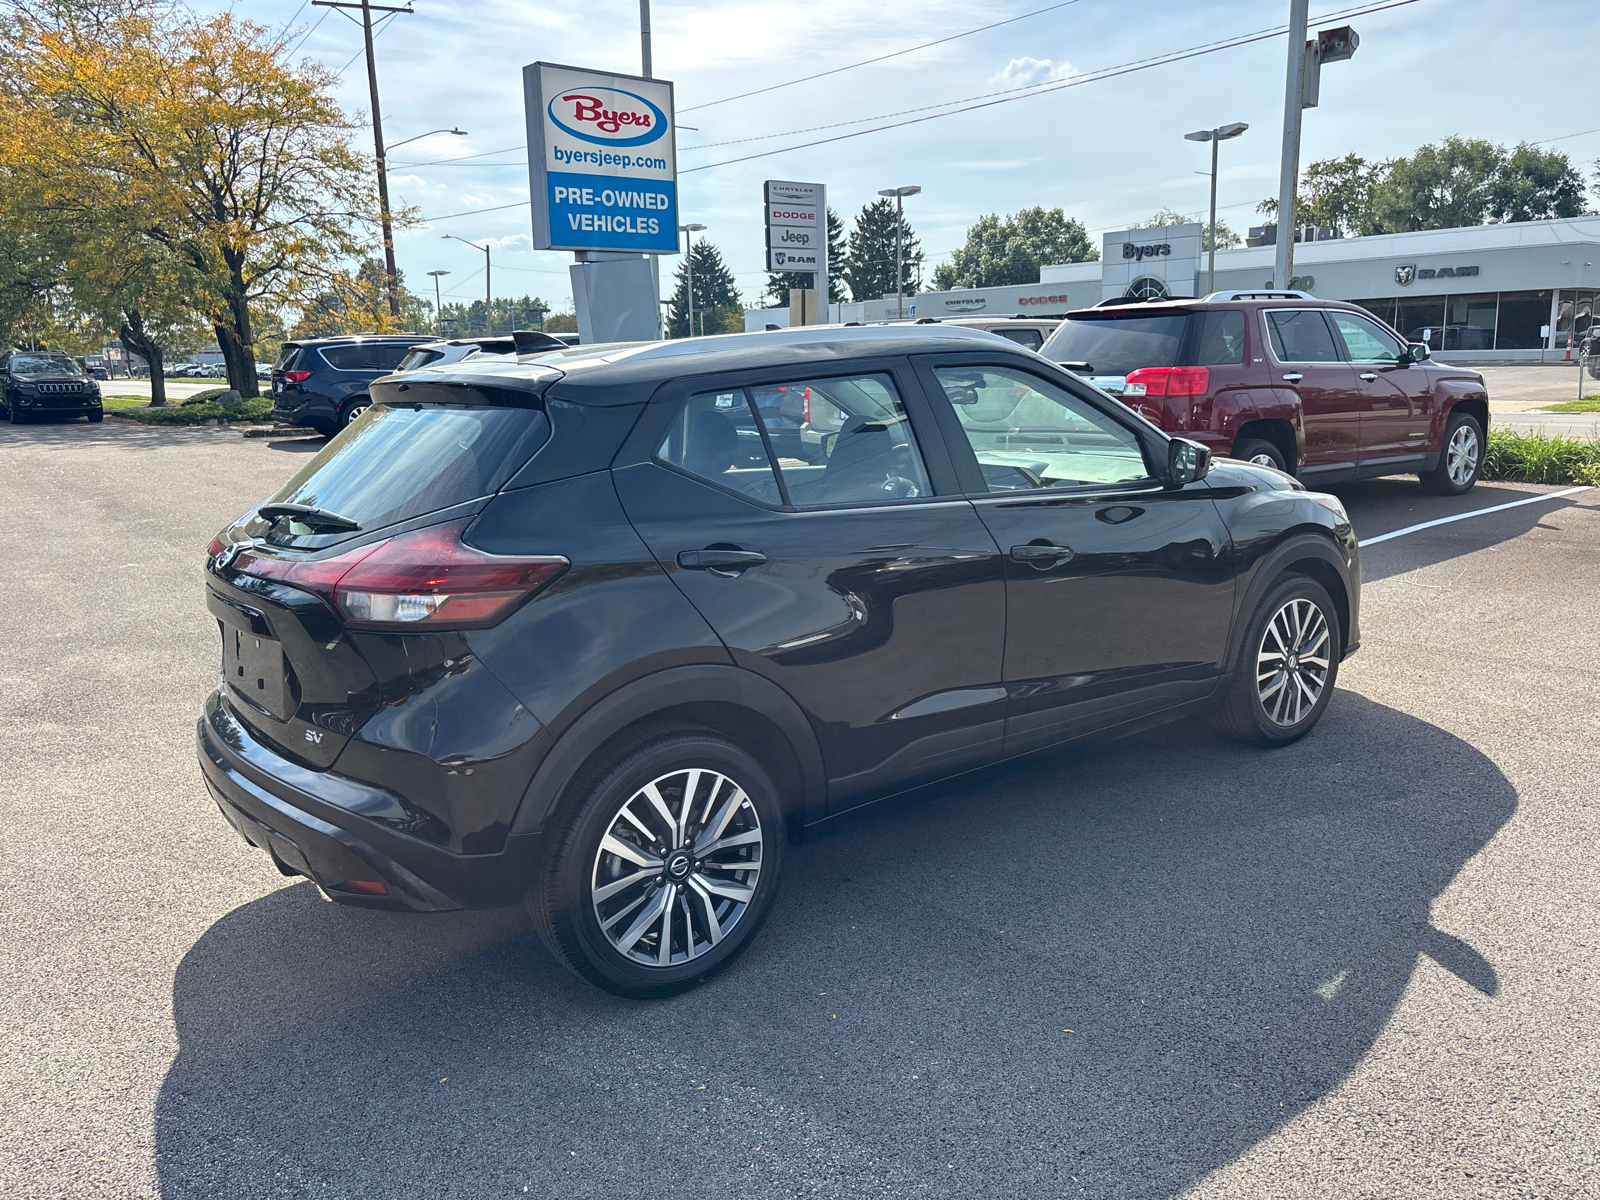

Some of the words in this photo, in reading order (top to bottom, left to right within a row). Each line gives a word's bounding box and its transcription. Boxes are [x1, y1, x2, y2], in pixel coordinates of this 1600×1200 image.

[562, 95, 651, 133] Byers
[554, 146, 666, 169] byersjeep.com
[554, 186, 669, 210] PRE-OWNED
[567, 213, 660, 235] VEHICLES
[773, 211, 815, 220] DODGE
[781, 229, 810, 246] Jeep
[1122, 243, 1171, 261] Byers
[1418, 265, 1480, 279] RAM
[1018, 294, 1068, 306] DODGE
[305, 729, 324, 744] SV
